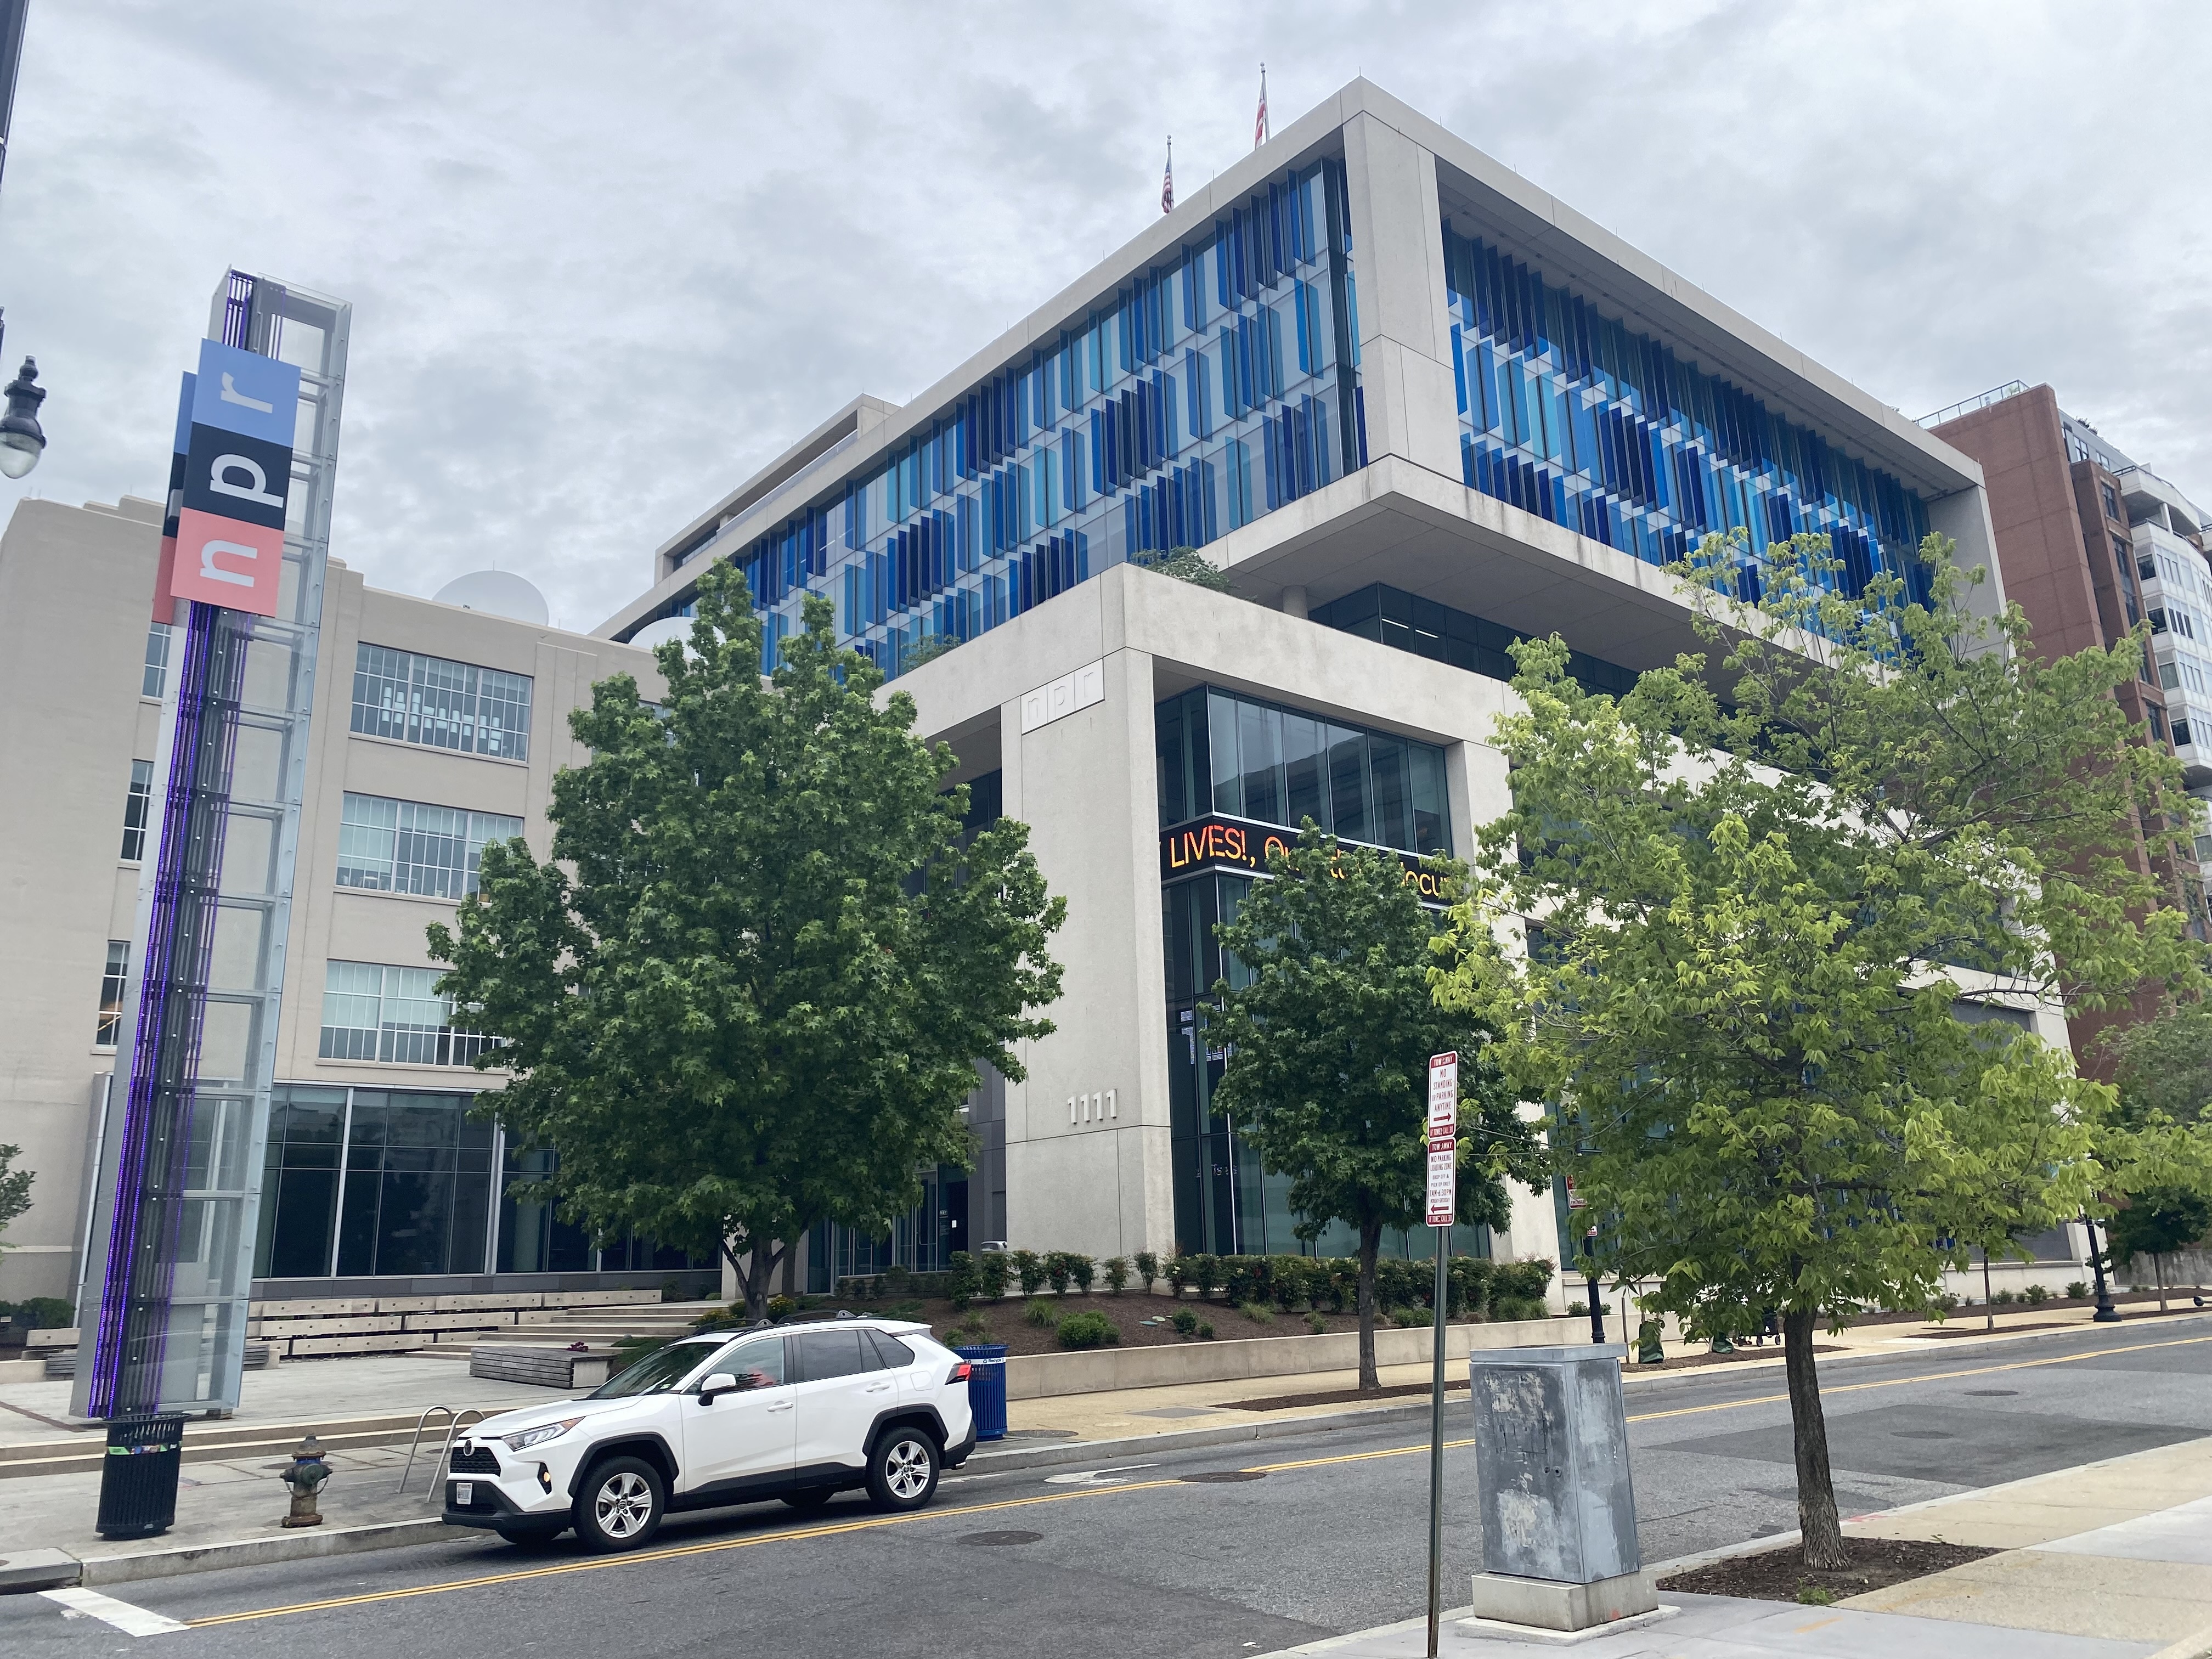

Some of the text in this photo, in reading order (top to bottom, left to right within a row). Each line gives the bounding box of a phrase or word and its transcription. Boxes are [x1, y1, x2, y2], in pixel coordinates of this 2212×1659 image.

[199, 371, 284, 588] npr
[1027, 672, 1094, 722] npr
[1440, 1068, 1447, 1078] NO
[1433, 1079, 1453, 1090] STANDING
[1436, 1090, 1453, 1101] PARKING
[1067, 1088, 1117, 1124] 1111
[1434, 1101, 1452, 1112] ANYTIME
[1437, 1153, 1452, 1162] PARKING
[1443, 1162, 1452, 1170] ZONE
